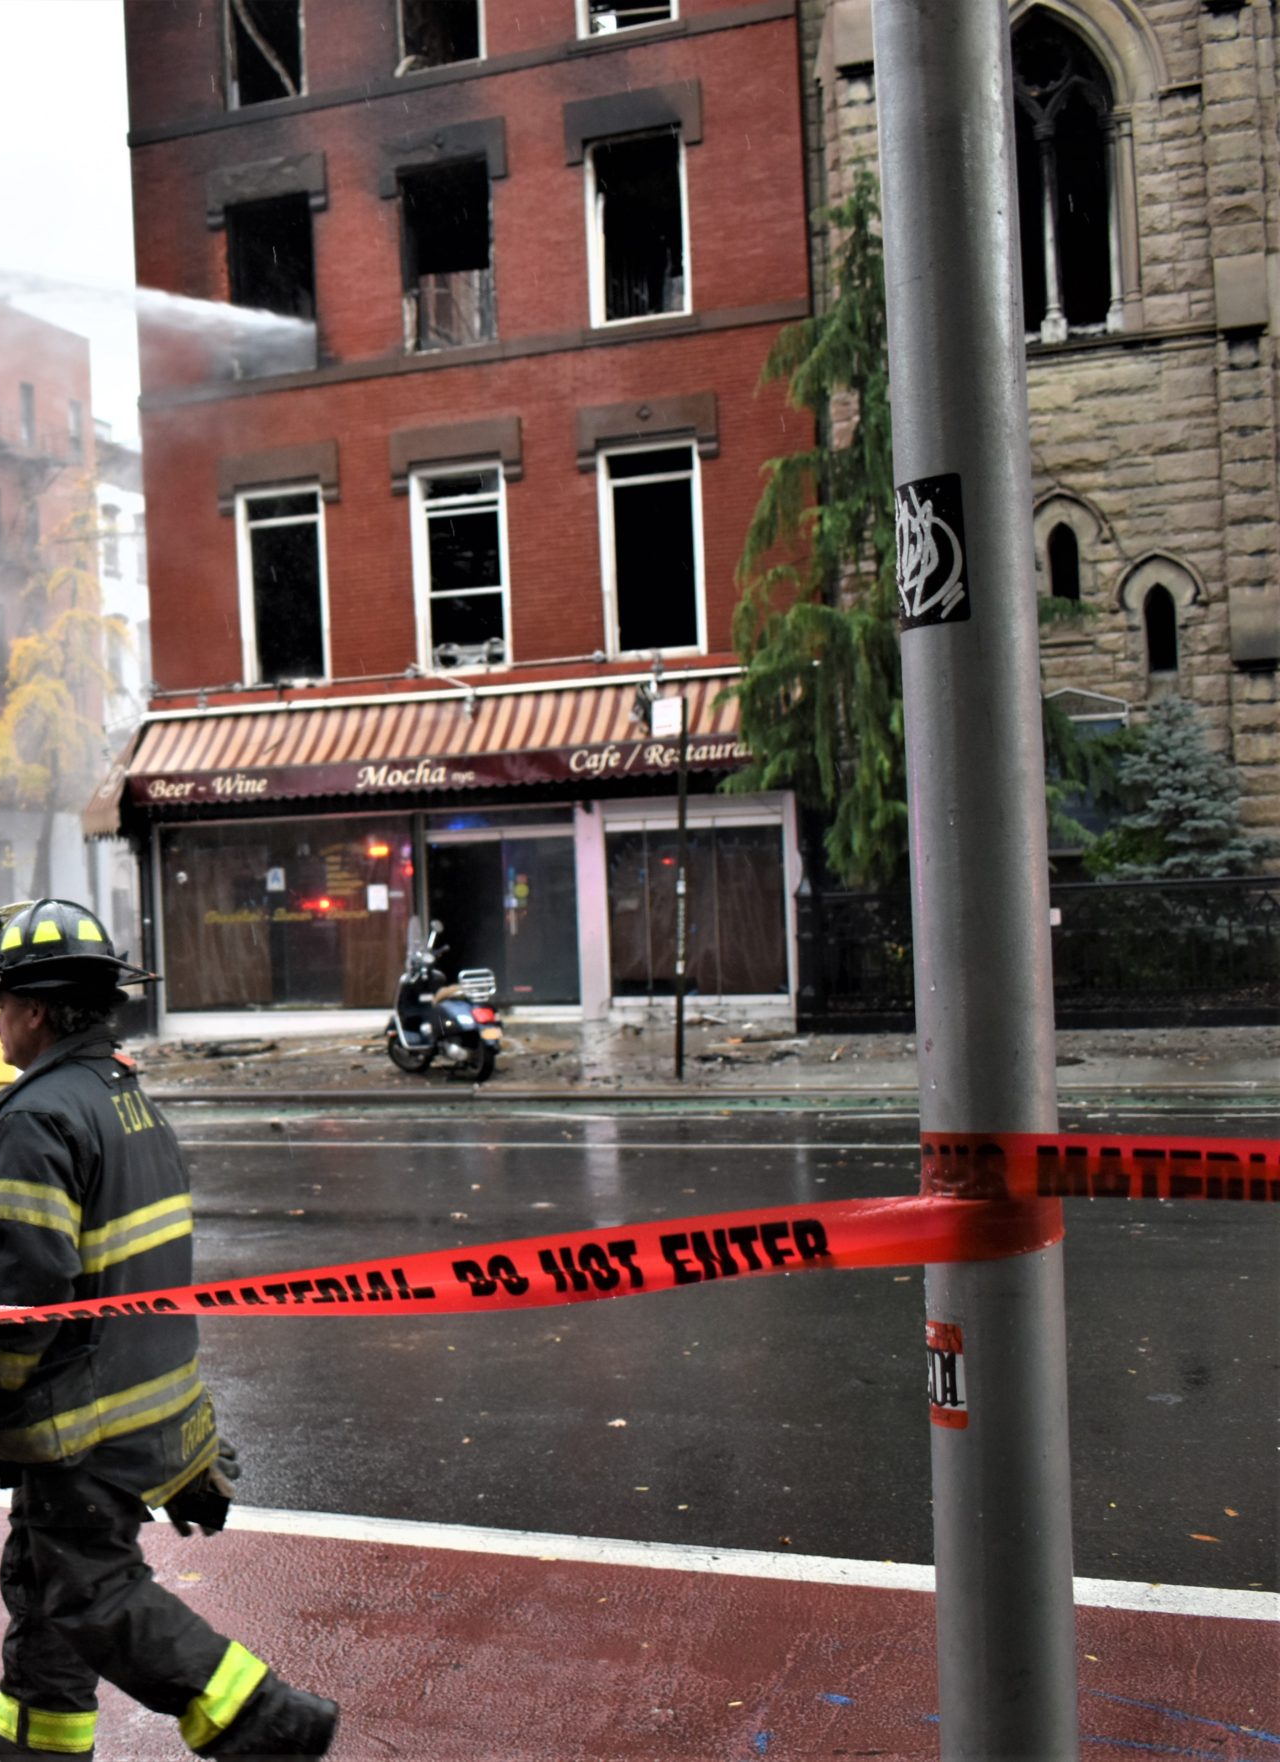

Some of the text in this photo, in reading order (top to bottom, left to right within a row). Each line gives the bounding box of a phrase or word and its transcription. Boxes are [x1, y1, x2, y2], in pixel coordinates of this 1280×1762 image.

[356, 758, 447, 788] Mocha
[570, 745, 621, 775] Cafe
[148, 779, 195, 799] Beer
[212, 773, 268, 796] Wine
[452, 1254, 529, 1297] DO
[537, 1239, 644, 1293] NOT
[659, 1218, 832, 1285] ENTER
